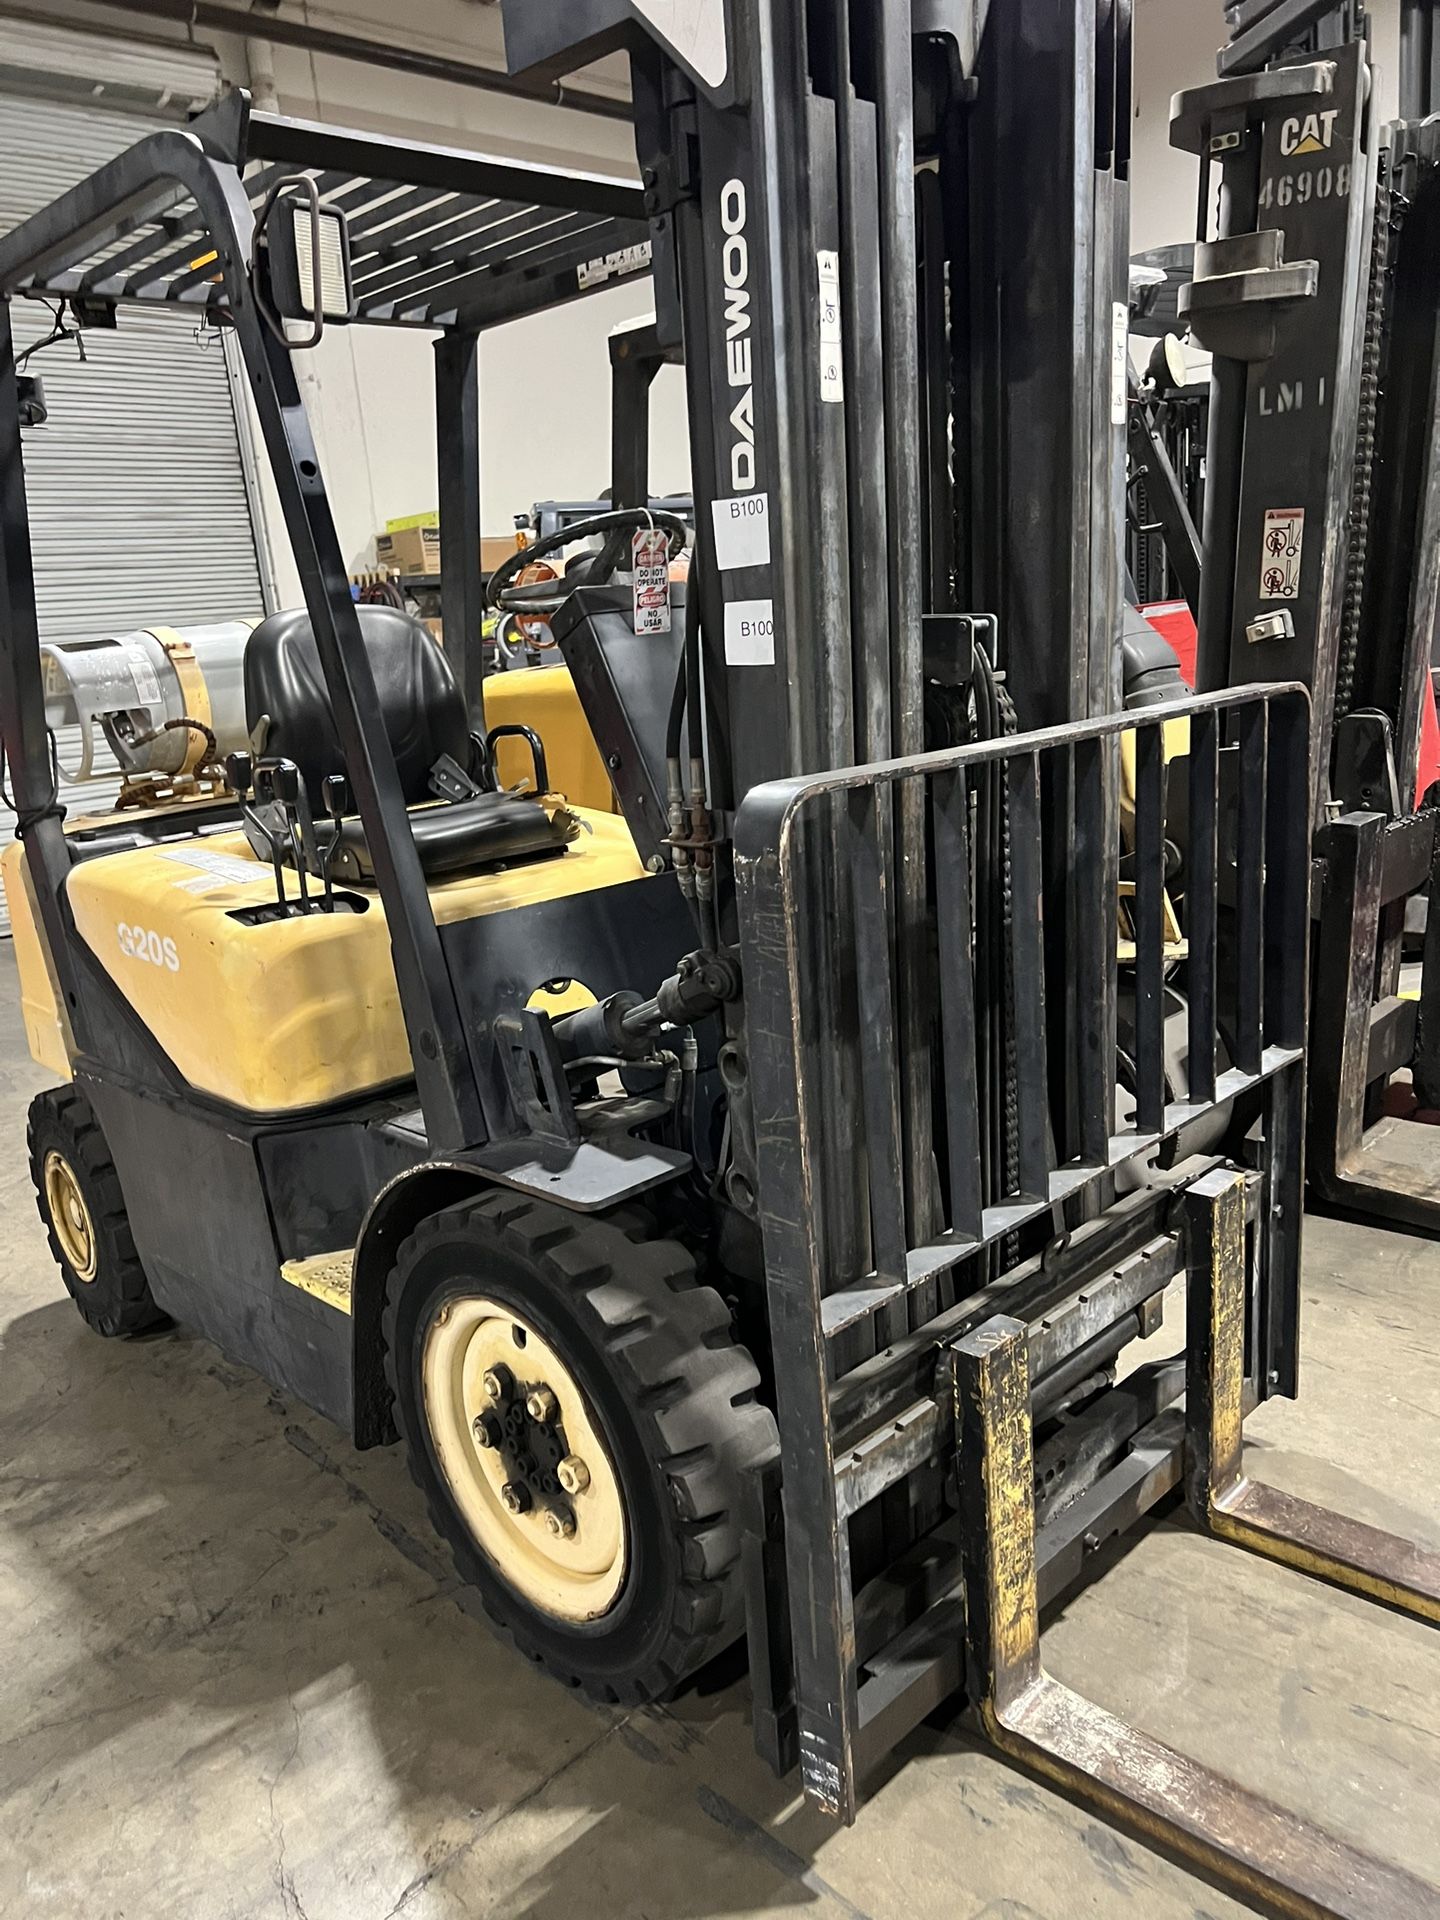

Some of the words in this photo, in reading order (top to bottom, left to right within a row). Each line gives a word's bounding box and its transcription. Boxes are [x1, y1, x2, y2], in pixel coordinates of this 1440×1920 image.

[1280, 109, 1338, 156] CAT
[1258, 164, 1351, 210] 46908
[720, 178, 756, 491] DAEWOO
[730, 498, 764, 518] B100
[637, 577, 666, 586] OPERATE
[639, 569, 649, 578] DO
[643, 618, 662, 627] USAR
[647, 609, 658, 618] NO
[741, 620, 774, 637] B100
[117, 921, 180, 973] G20S
